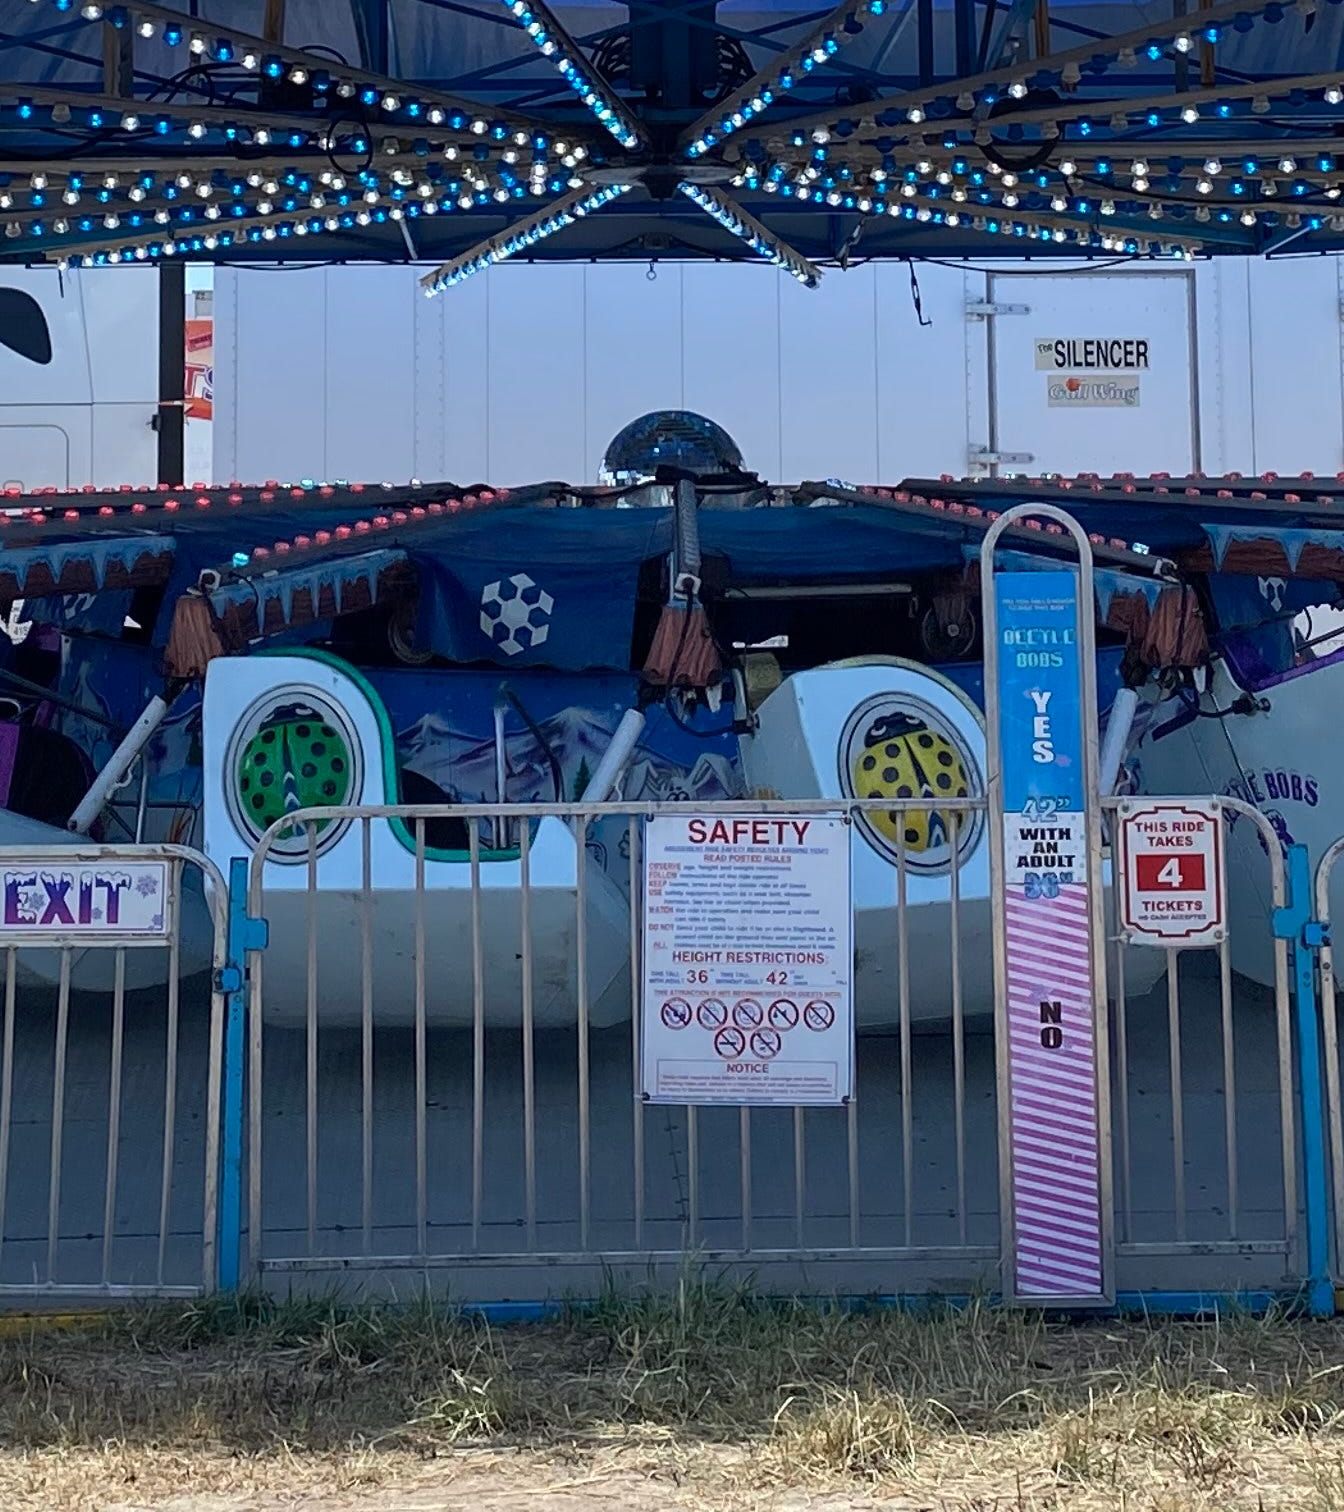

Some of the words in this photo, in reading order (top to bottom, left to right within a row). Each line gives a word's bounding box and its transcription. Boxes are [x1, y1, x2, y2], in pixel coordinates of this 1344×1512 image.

[1054, 339, 1149, 368] SILENCER
[1092, 382, 1139, 405] Wing
[1016, 651, 1063, 668] BOBS
[1031, 691, 1054, 764] YES
[1264, 769, 1318, 807] BOBS
[688, 819, 810, 845] SAFETY
[1019, 828, 1071, 840] WITH
[1135, 822, 1168, 833] THIS
[1172, 821, 1205, 832] RIDE
[1033, 842, 1058, 854] AN
[1147, 836, 1193, 847] TAKES
[704, 854, 727, 862] READ
[1016, 855, 1075, 867] ADULT
[1157, 857, 1183, 888] 4
[4, 871, 132, 924] EXIT
[1142, 901, 1203, 912] TICKETS
[672, 951, 722, 963] HEIGHT
[1040, 1001, 1063, 1049] NO
[727, 1064, 769, 1073] NOTICE
